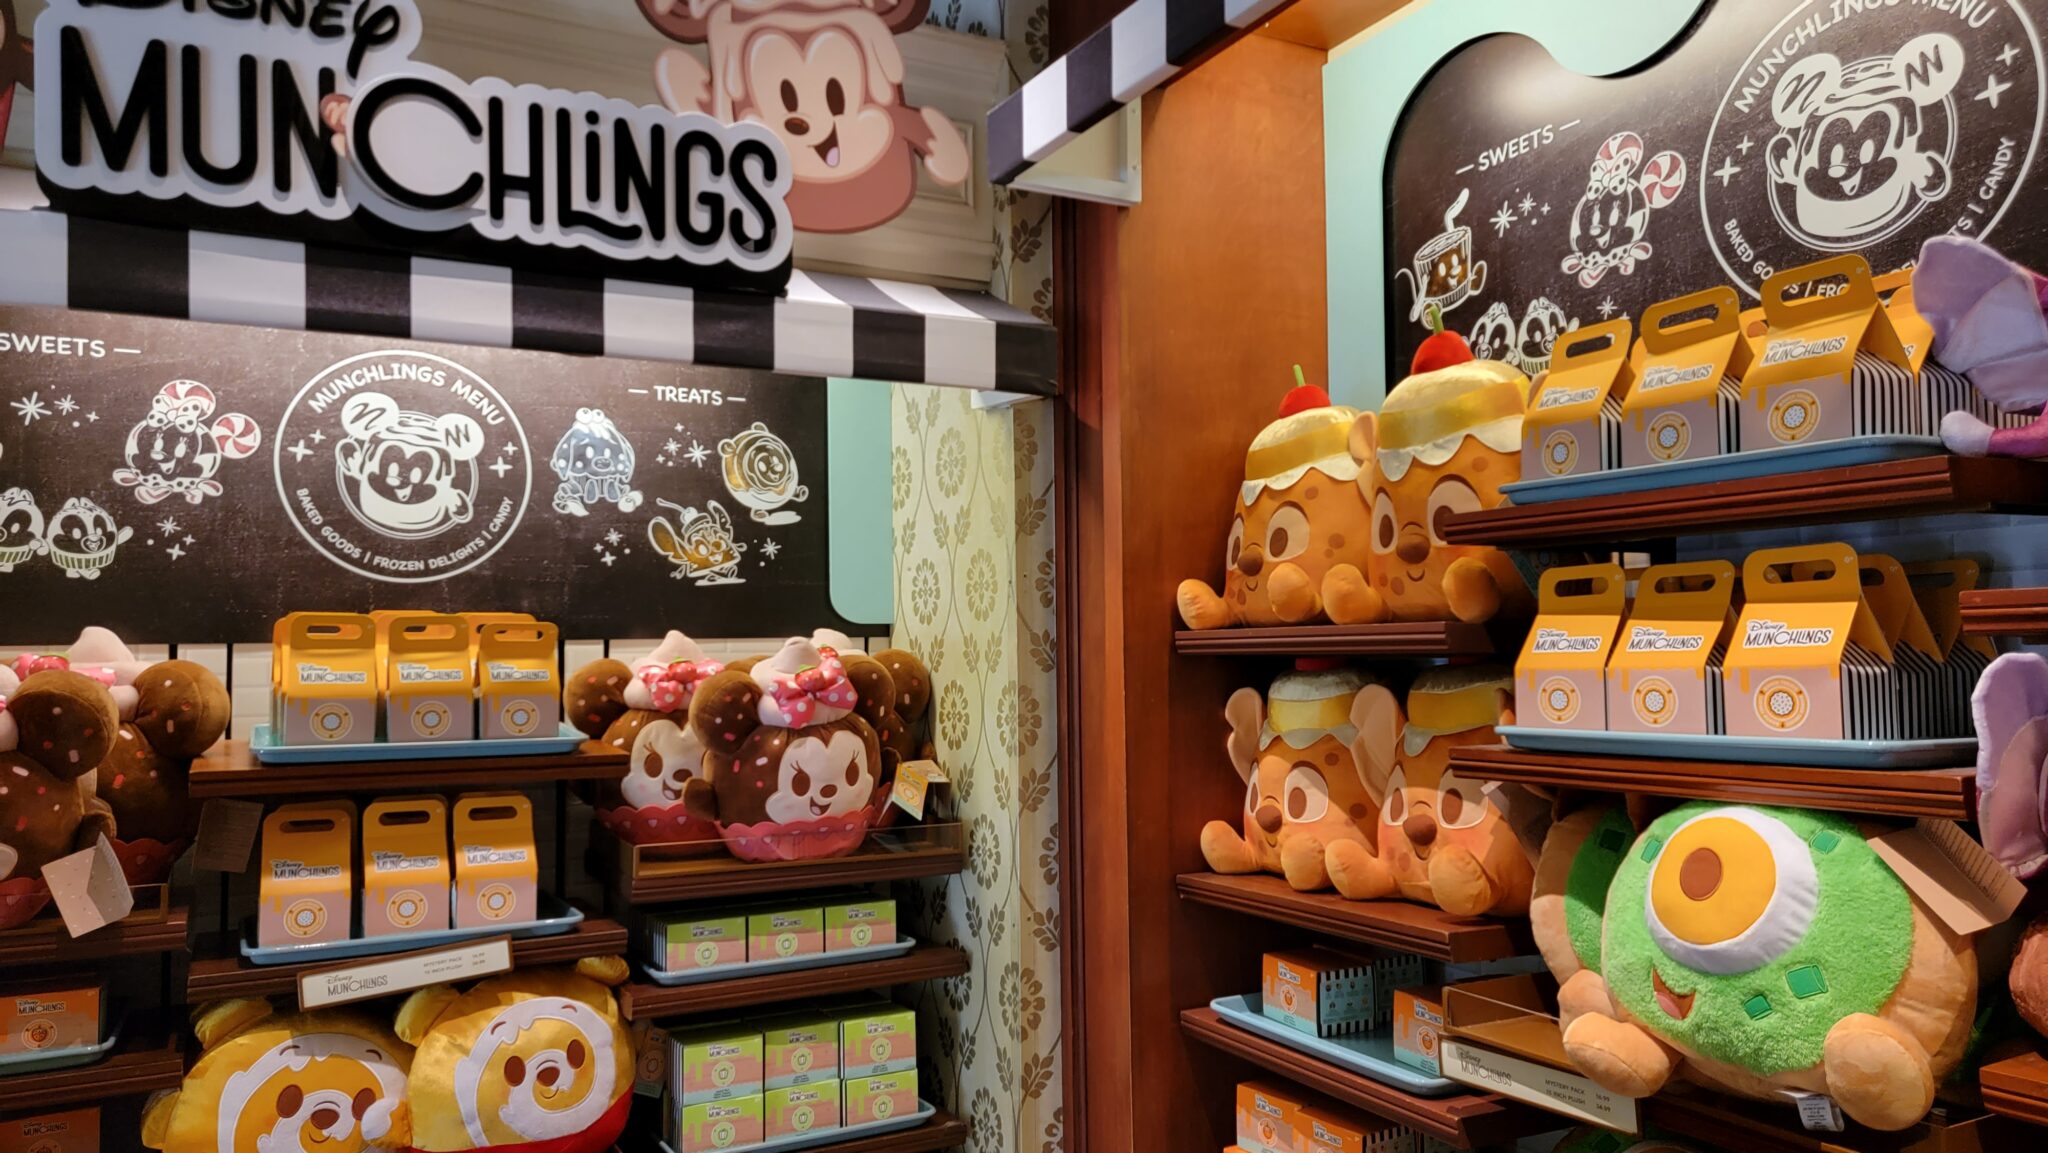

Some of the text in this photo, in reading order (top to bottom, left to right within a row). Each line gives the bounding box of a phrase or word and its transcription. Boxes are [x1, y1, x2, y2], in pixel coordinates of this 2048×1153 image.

[1478, 124, 1555, 172] SWEETS
[1724, 218, 1754, 264] BAKED
[1752, 260, 1799, 294] GOS
[1979, 137, 2017, 201] CANDY
[0, 333, 105, 357] SWEETS
[1763, 337, 1845, 365] MUNCHLINGS
[308, 363, 506, 426] MUNCHLINGS MENU
[653, 385, 723, 406] TREATS
[296, 487, 514, 571] BAKED GOODS FROZEN DELIGHTS CANDY
[1533, 636, 1600, 651] MUNCHLINGS
[1628, 636, 1702, 650] MUNCHLINGS
[1744, 630, 1831, 647] MUNCHLINGS
[327, 975, 388, 997] MUNCHLINGS
[1460, 1061, 1512, 1087] MUNCHLINGS
